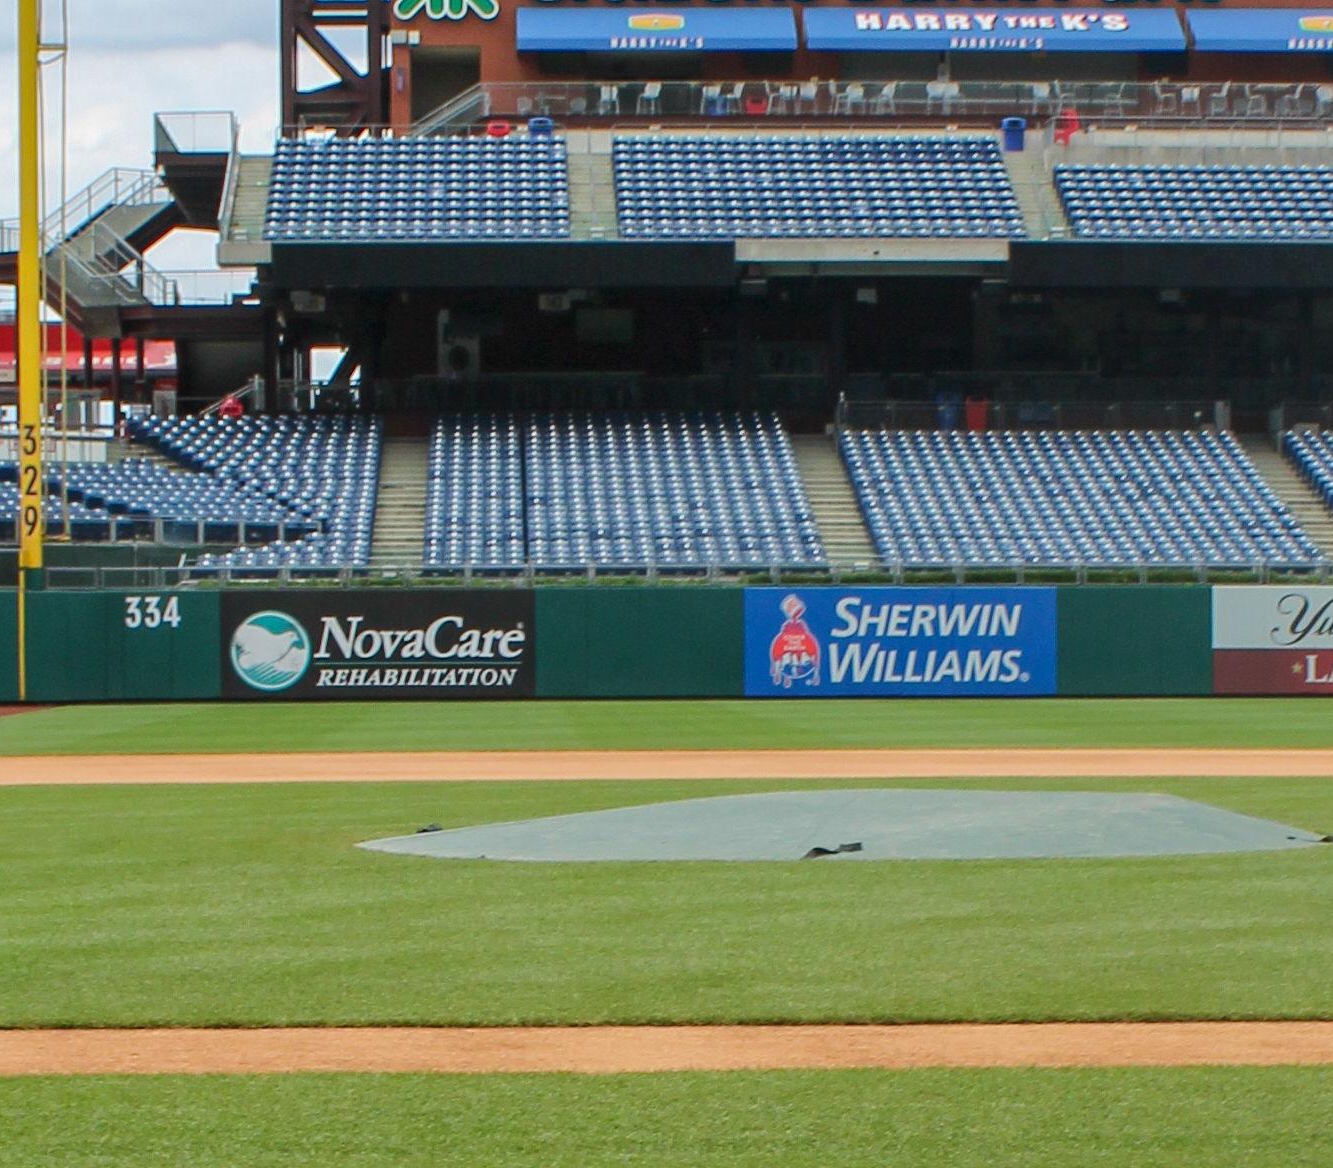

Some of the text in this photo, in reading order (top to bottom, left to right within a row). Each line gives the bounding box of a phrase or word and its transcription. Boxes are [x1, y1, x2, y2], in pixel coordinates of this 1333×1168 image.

[855, 13, 1129, 31] HARRY THE K'S
[124, 596, 182, 629] 334
[830, 597, 1022, 637] SHERWIN
[314, 616, 526, 659] NovaCare
[316, 668, 517, 687] REHABILITATION
